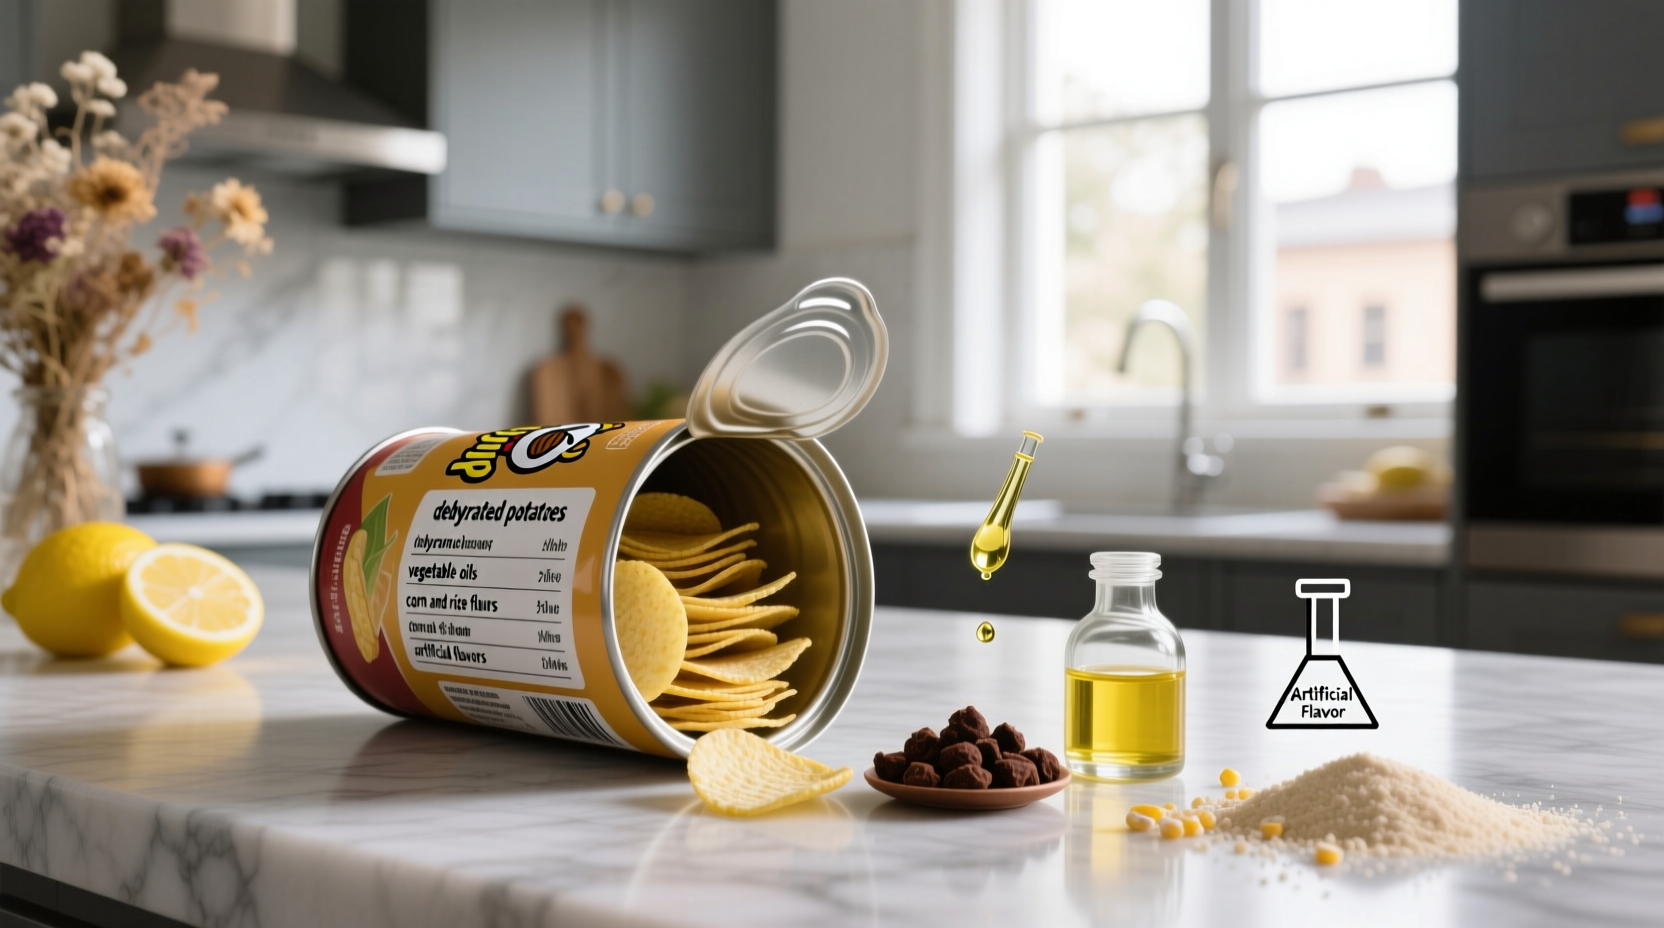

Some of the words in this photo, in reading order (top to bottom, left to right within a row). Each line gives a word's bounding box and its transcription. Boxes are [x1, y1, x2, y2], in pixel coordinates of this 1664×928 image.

[407, 562, 457, 583] vegetable
[459, 563, 478, 581] oils
[406, 595, 428, 608] corn
[429, 594, 448, 610] and
[453, 645, 487, 664] flavors
